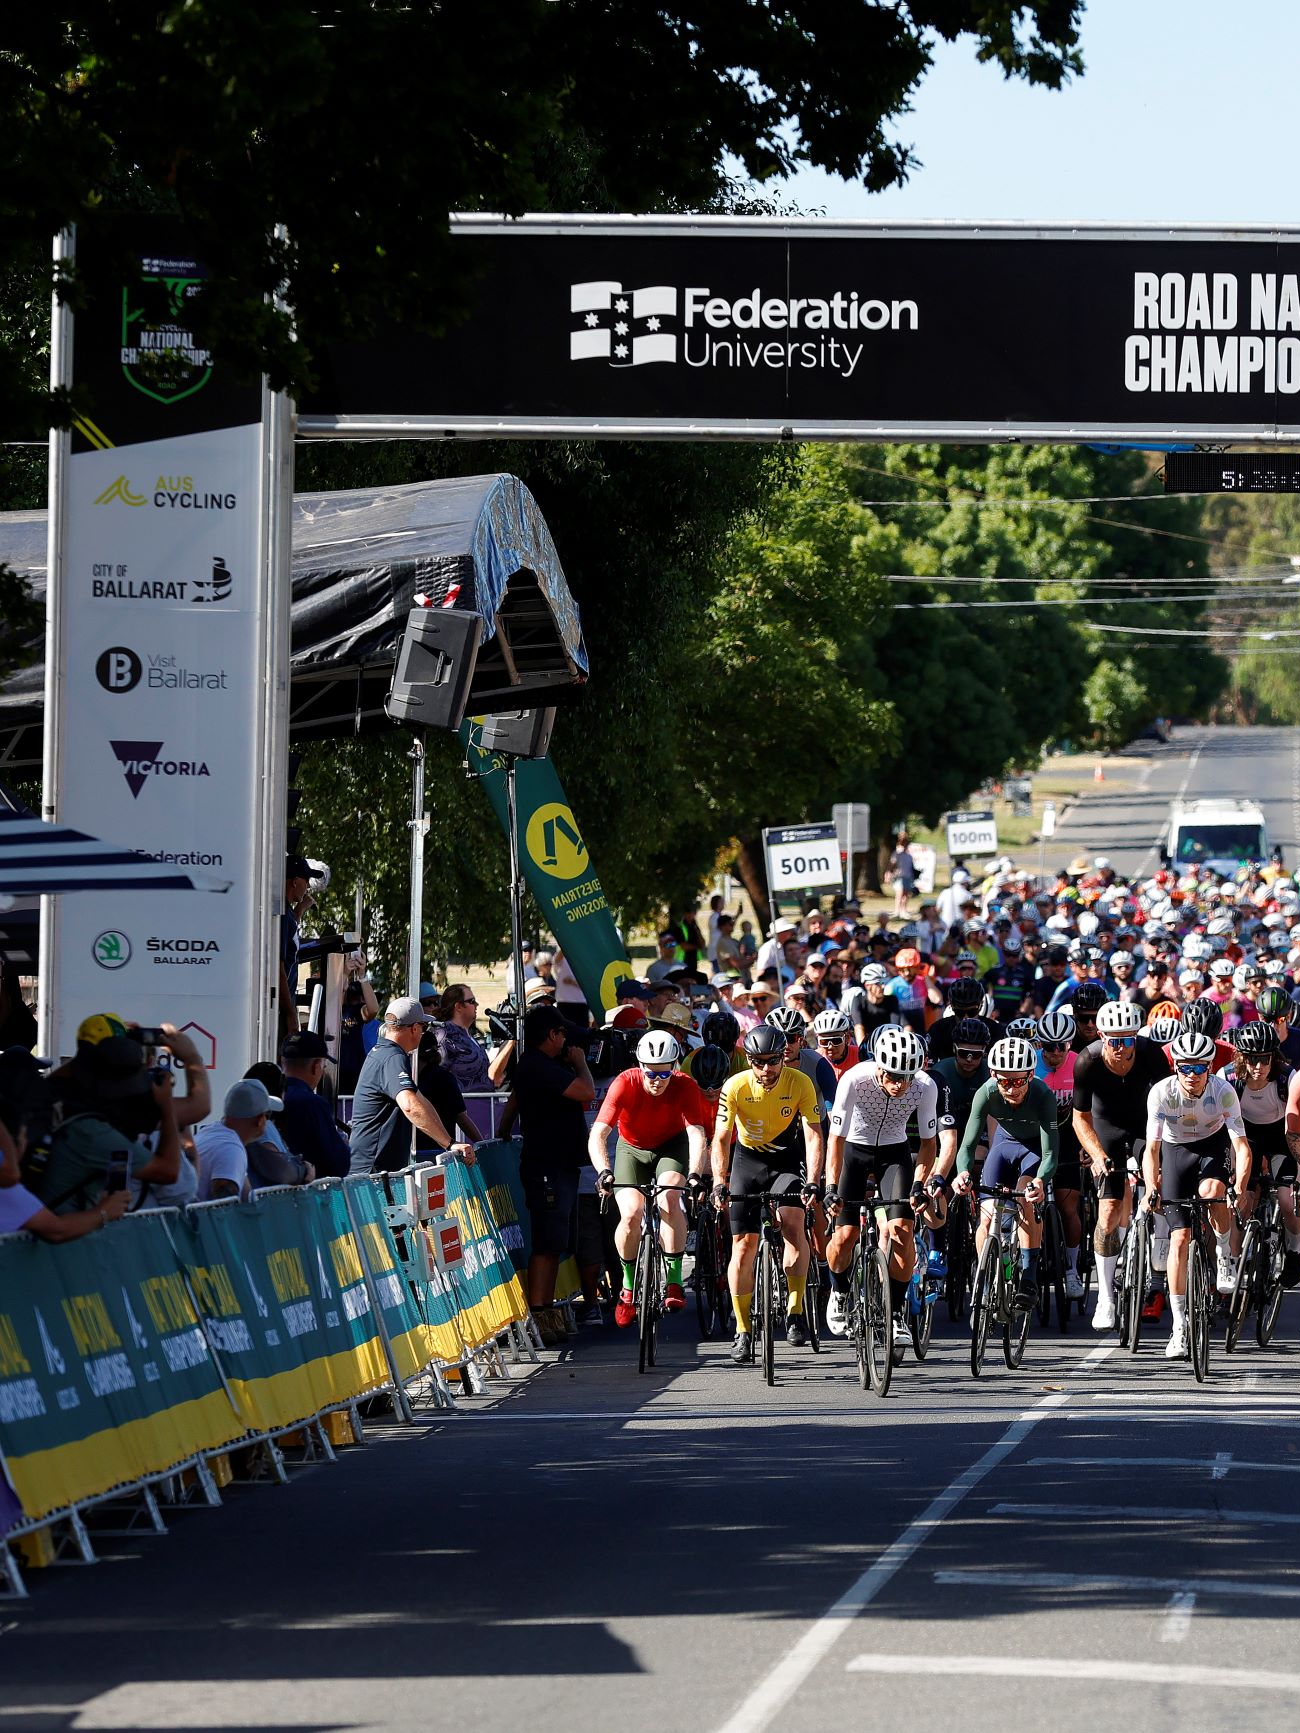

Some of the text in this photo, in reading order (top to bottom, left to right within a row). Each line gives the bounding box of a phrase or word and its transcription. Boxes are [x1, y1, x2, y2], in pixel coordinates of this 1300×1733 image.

[684, 287, 919, 330] Federation
[1133, 271, 1239, 330] ROAD
[140, 331, 196, 349] NATIONAL
[684, 333, 864, 378] University
[155, 475, 193, 492] AUS
[154, 491, 237, 510] CYCLING
[92, 563, 128, 578] CITY OF
[92, 579, 188, 600] BALLARAT
[147, 653, 177, 668] Visit
[147, 667, 228, 690] Ballarat
[119, 759, 211, 777] VICTORIA
[953, 831, 993, 846] 100m
[136, 849, 223, 866] deration
[781, 856, 830, 875] 50m
[146, 936, 220, 953] ŠKODA
[153, 956, 213, 965] BALLARAT
